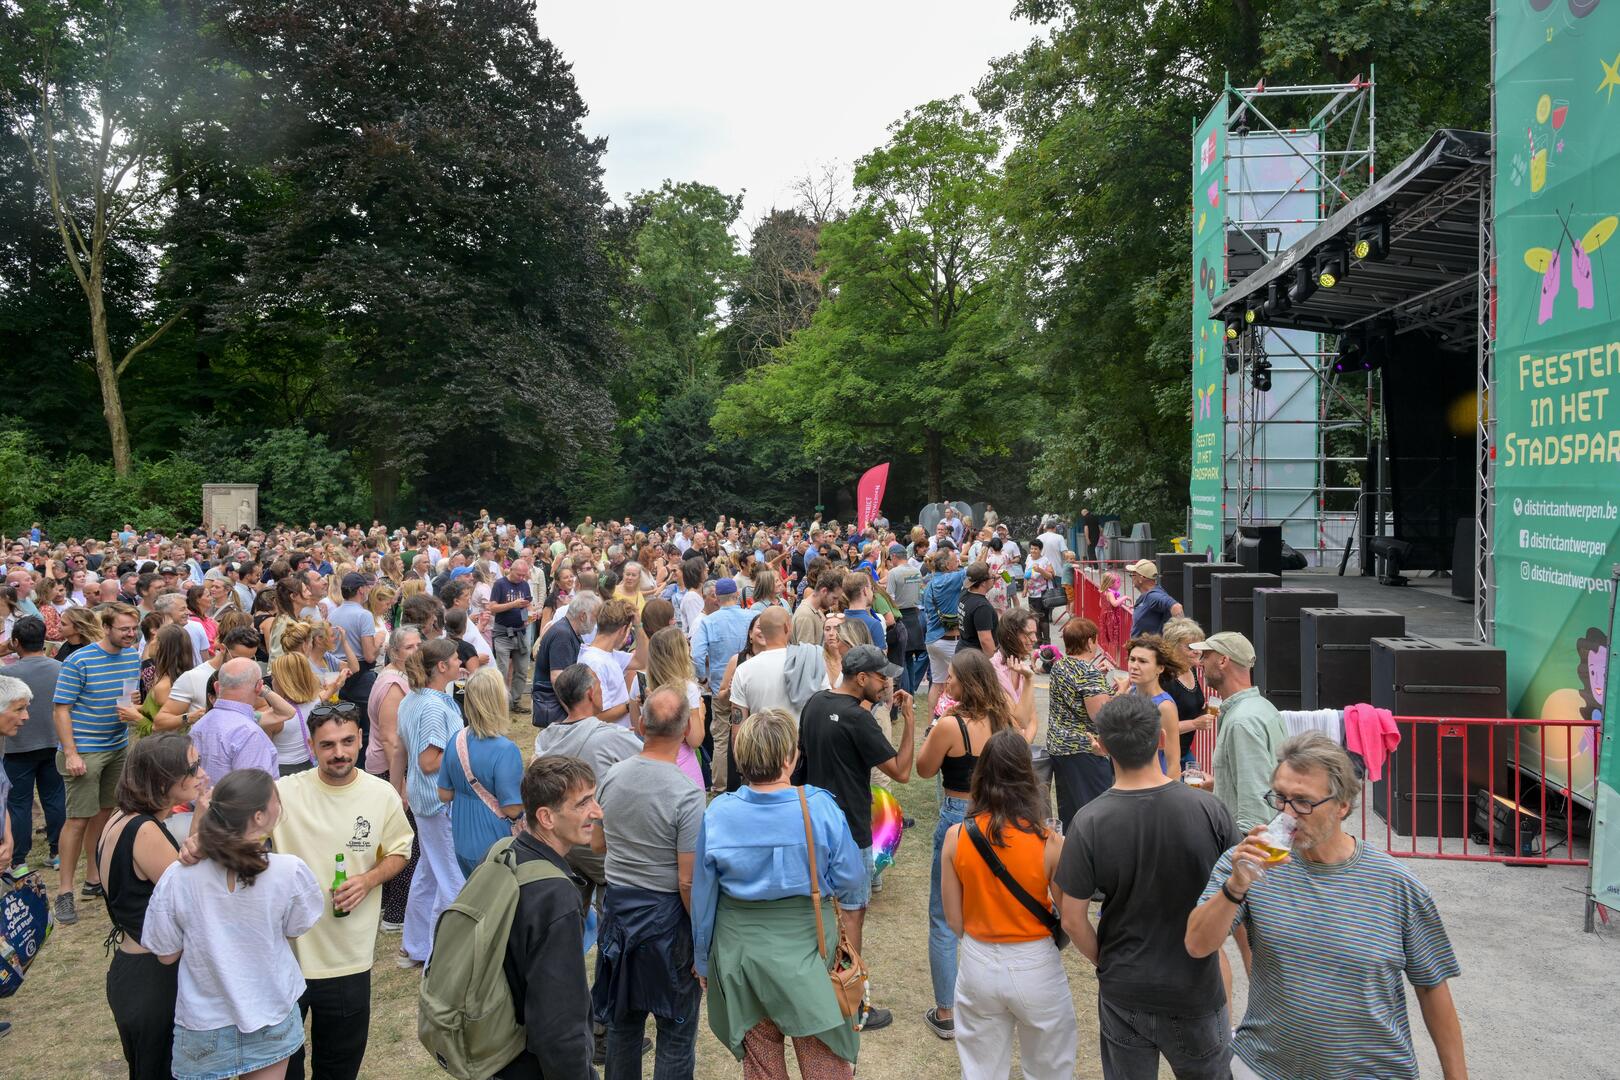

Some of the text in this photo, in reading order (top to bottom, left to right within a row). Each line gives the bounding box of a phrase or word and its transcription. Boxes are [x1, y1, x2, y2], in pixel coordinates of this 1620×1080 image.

[1561, 388, 1609, 424] HET
[1524, 500, 1618, 522] districtantwerpen.be
[1530, 532, 1606, 558] districtantwerpen
[1531, 564, 1612, 594] districtantwerpen
